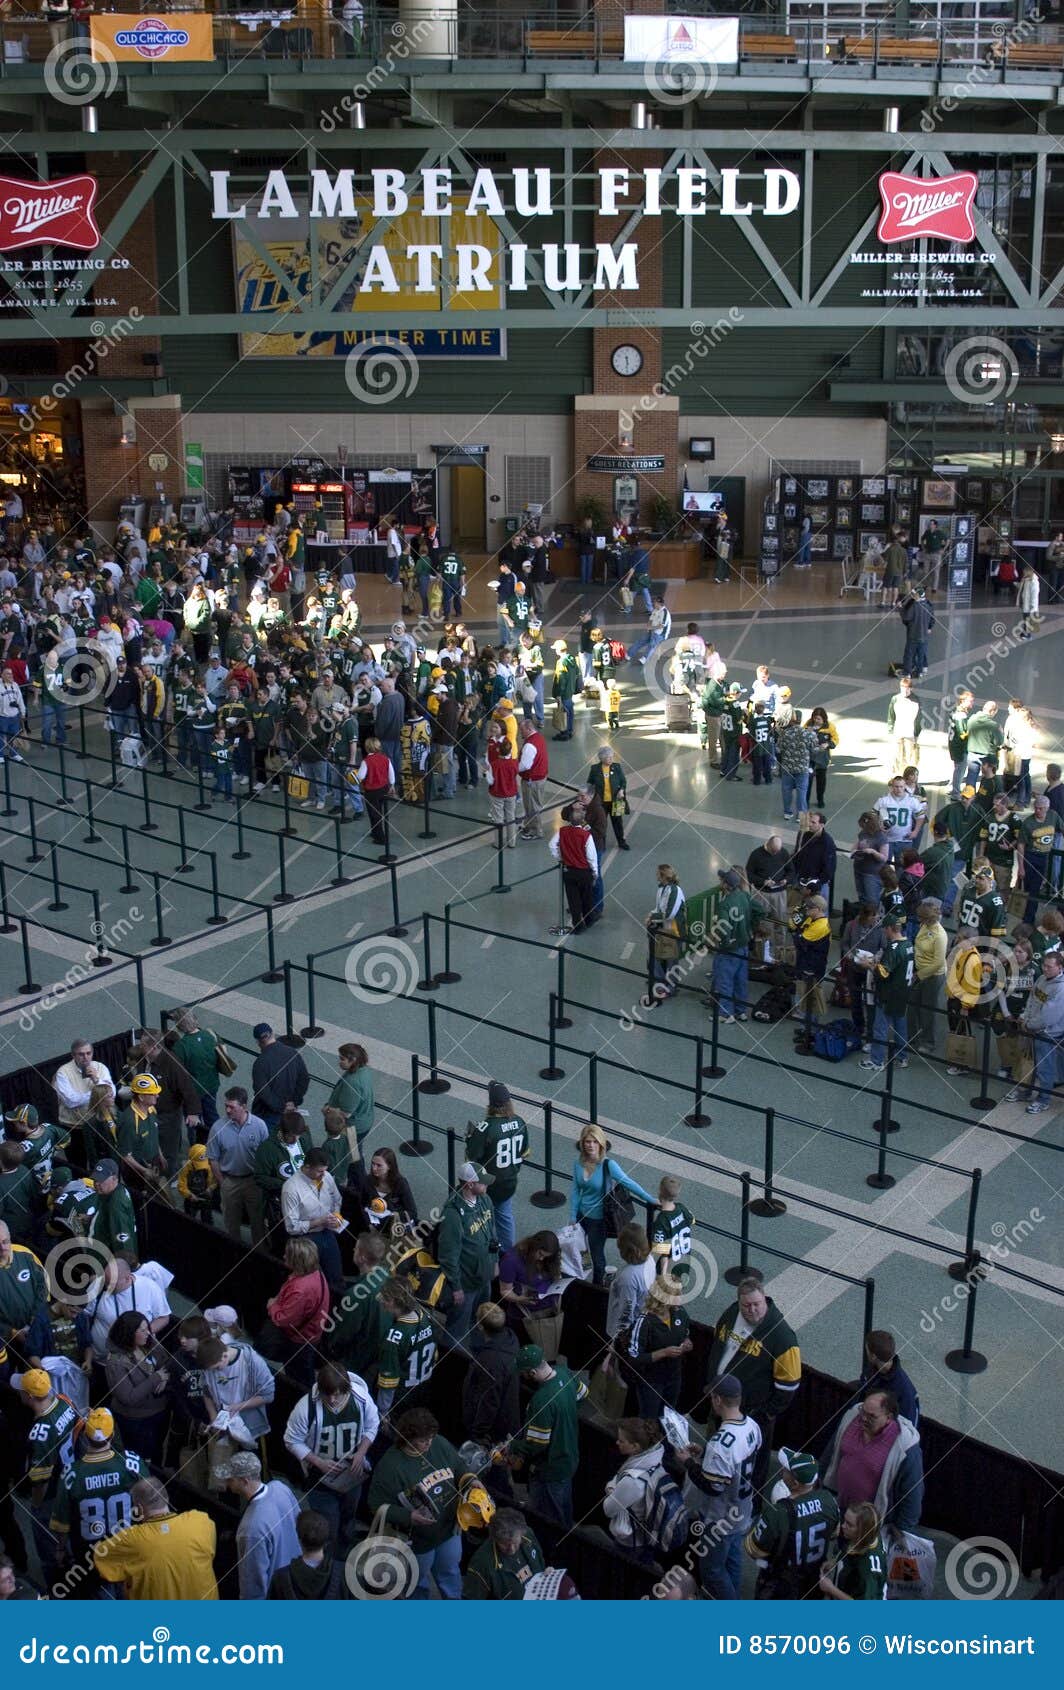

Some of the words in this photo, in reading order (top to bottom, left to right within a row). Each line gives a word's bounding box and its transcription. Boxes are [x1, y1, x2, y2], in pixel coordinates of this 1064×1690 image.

[117, 34, 138, 44] OLD
[140, 33, 188, 44] CHICAGO
[209, 168, 553, 219] LAMBEAU
[599, 167, 801, 217] FIELD
[4, 194, 84, 234] Miller
[892, 191, 965, 227] Miller
[31, 259, 106, 271] BREWING
[850, 253, 908, 264] MILLER
[910, 252, 976, 264] BREWING
[359, 242, 641, 294] ATRIUM
[892, 272, 926, 281] SINCE
[930, 270, 957, 283] 1855
[15, 280, 55, 290] SINCE
[56, 278, 84, 292] 1855
[862, 288, 933, 298] MILWAUKEE,
[962, 289, 984, 298] USA
[94, 298, 118, 307] USA
[342, 329, 426, 347] MILLER
[437, 329, 493, 347] TIME
[594, 460, 617, 469] GUEST
[617, 460, 659, 469] RELATIONS
[443, 561, 458, 575] 30
[46, 673, 64, 691] 74
[754, 727, 769, 742] 85
[886, 807, 910, 827] 50
[988, 821, 1010, 842] 97
[959, 899, 984, 928] 56
[495, 1134, 525, 1169] 80
[671, 1226, 692, 1262] 66
[386, 1328, 403, 1345] 12
[404, 1341, 436, 1388] 12
[28, 1422, 51, 1442] 85
[84, 1471, 121, 1491] DRIVER
[79, 1491, 133, 1541] 80
[795, 1520, 827, 1566] 15
[868, 1554, 883, 1573] 11
